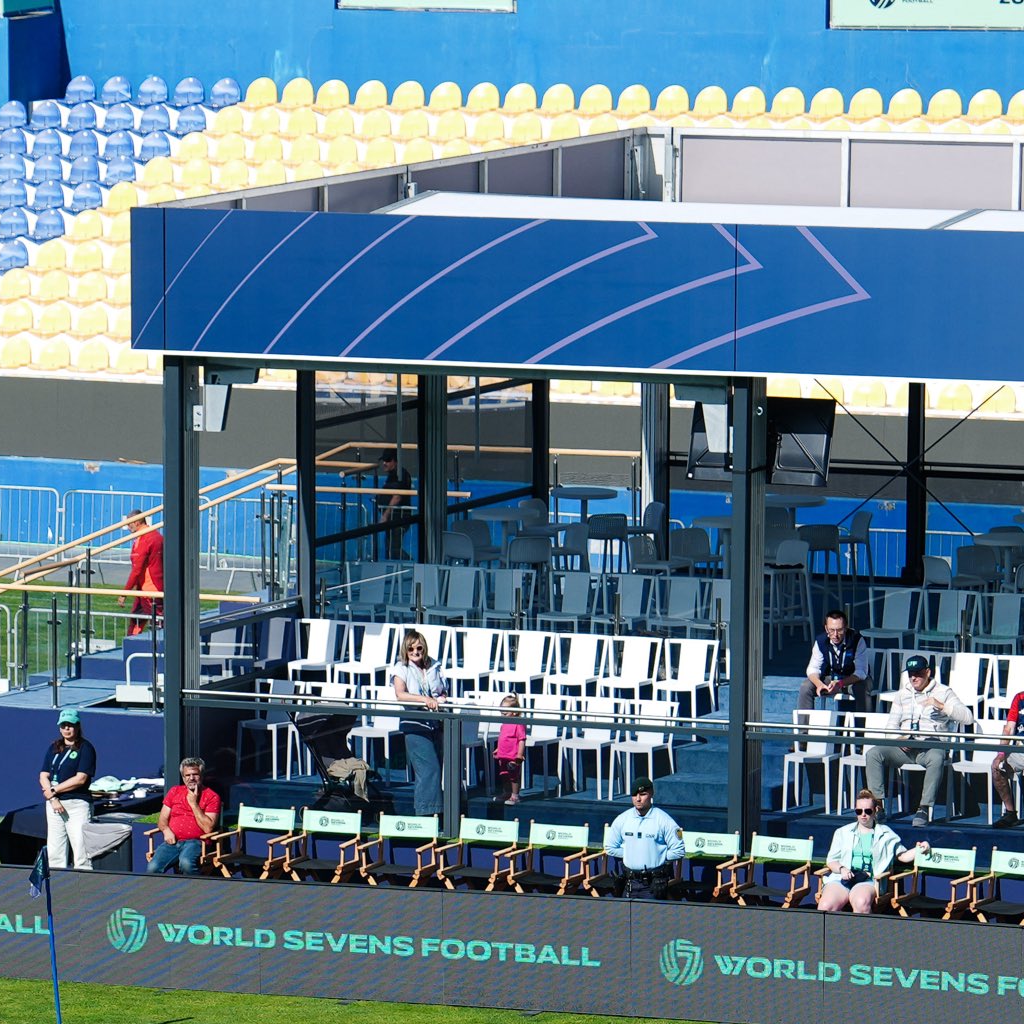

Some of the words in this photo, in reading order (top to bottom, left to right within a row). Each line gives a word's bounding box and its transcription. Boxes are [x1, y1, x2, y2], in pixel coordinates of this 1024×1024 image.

[157, 922, 276, 948] WORLD
[282, 930, 414, 957] SEVENS
[421, 937, 601, 967] FOOTBALL
[714, 954, 842, 983] WORLD
[849, 963, 989, 995] SEVENS
